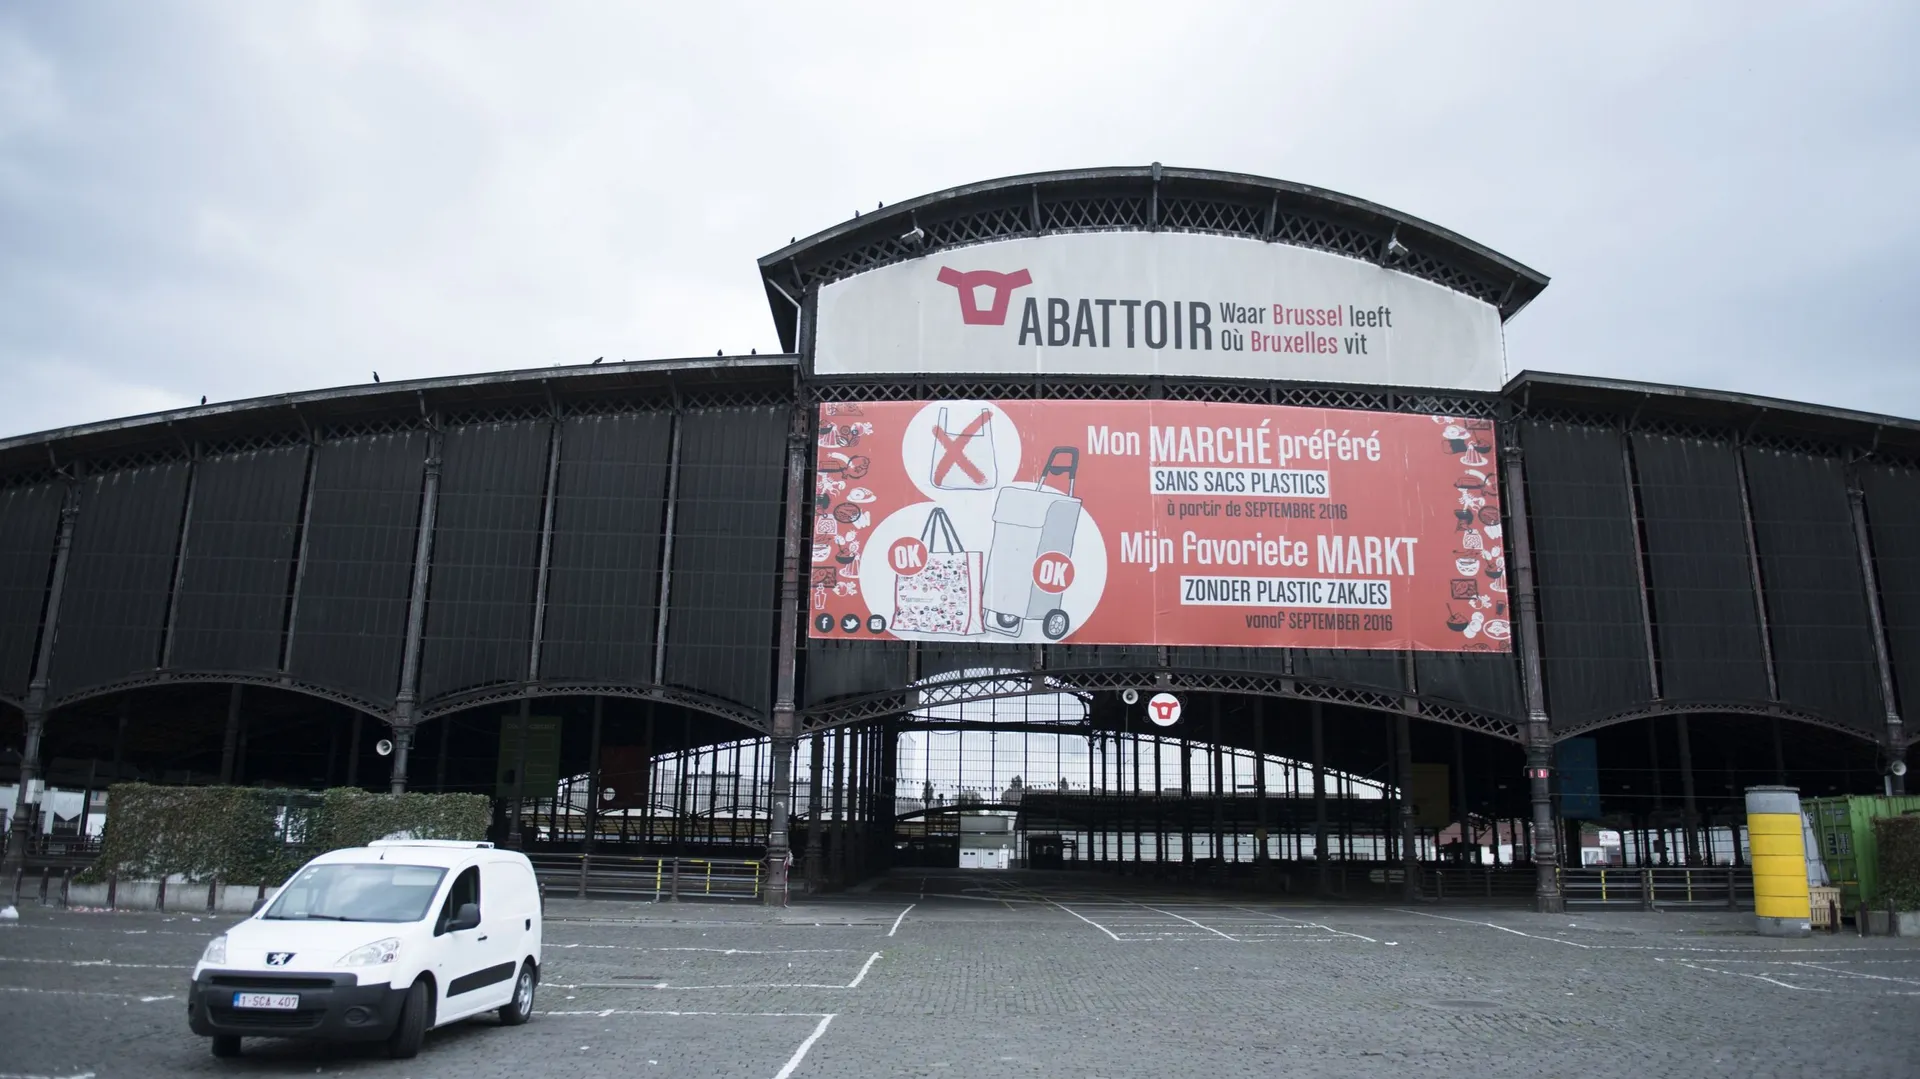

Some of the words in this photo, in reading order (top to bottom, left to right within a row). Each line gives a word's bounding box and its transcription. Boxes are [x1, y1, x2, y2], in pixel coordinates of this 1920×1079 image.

[1018, 297, 1212, 350] ABATTOIR
[1219, 302, 1266, 324] Waar
[1273, 303, 1343, 327] Brussel
[1349, 304, 1392, 328] leeft
[1221, 328, 1243, 351] Où
[1251, 330, 1338, 354] Bruxelles
[1344, 332, 1367, 355] vit
[1087, 425, 1140, 456] Mon
[1150, 418, 1272, 464] MARCHÉ
[1278, 428, 1381, 466] préféré
[1155, 470, 1199, 492] SANS
[1204, 471, 1245, 493] SACS
[1251, 472, 1326, 495] PLASTICS
[1167, 499, 1175, 516] à
[1180, 500, 1222, 520] partir
[1225, 500, 1241, 518] de
[1245, 501, 1315, 519] SEPTEMBRE
[1319, 503, 1348, 520] 2016
[894, 544, 922, 570] OK
[1120, 530, 1174, 572] Mijn
[1183, 530, 1309, 567] favoriete
[1317, 534, 1418, 576] MARKT
[1039, 559, 1069, 587] OK
[1185, 579, 1251, 602] ZONDER
[1257, 580, 1322, 604] PLASTIC
[1327, 581, 1388, 605] ZAKJES
[1245, 611, 1285, 629] vanaf
[1289, 612, 1360, 631] SEPTEMBER
[1363, 613, 1393, 632] 2016
